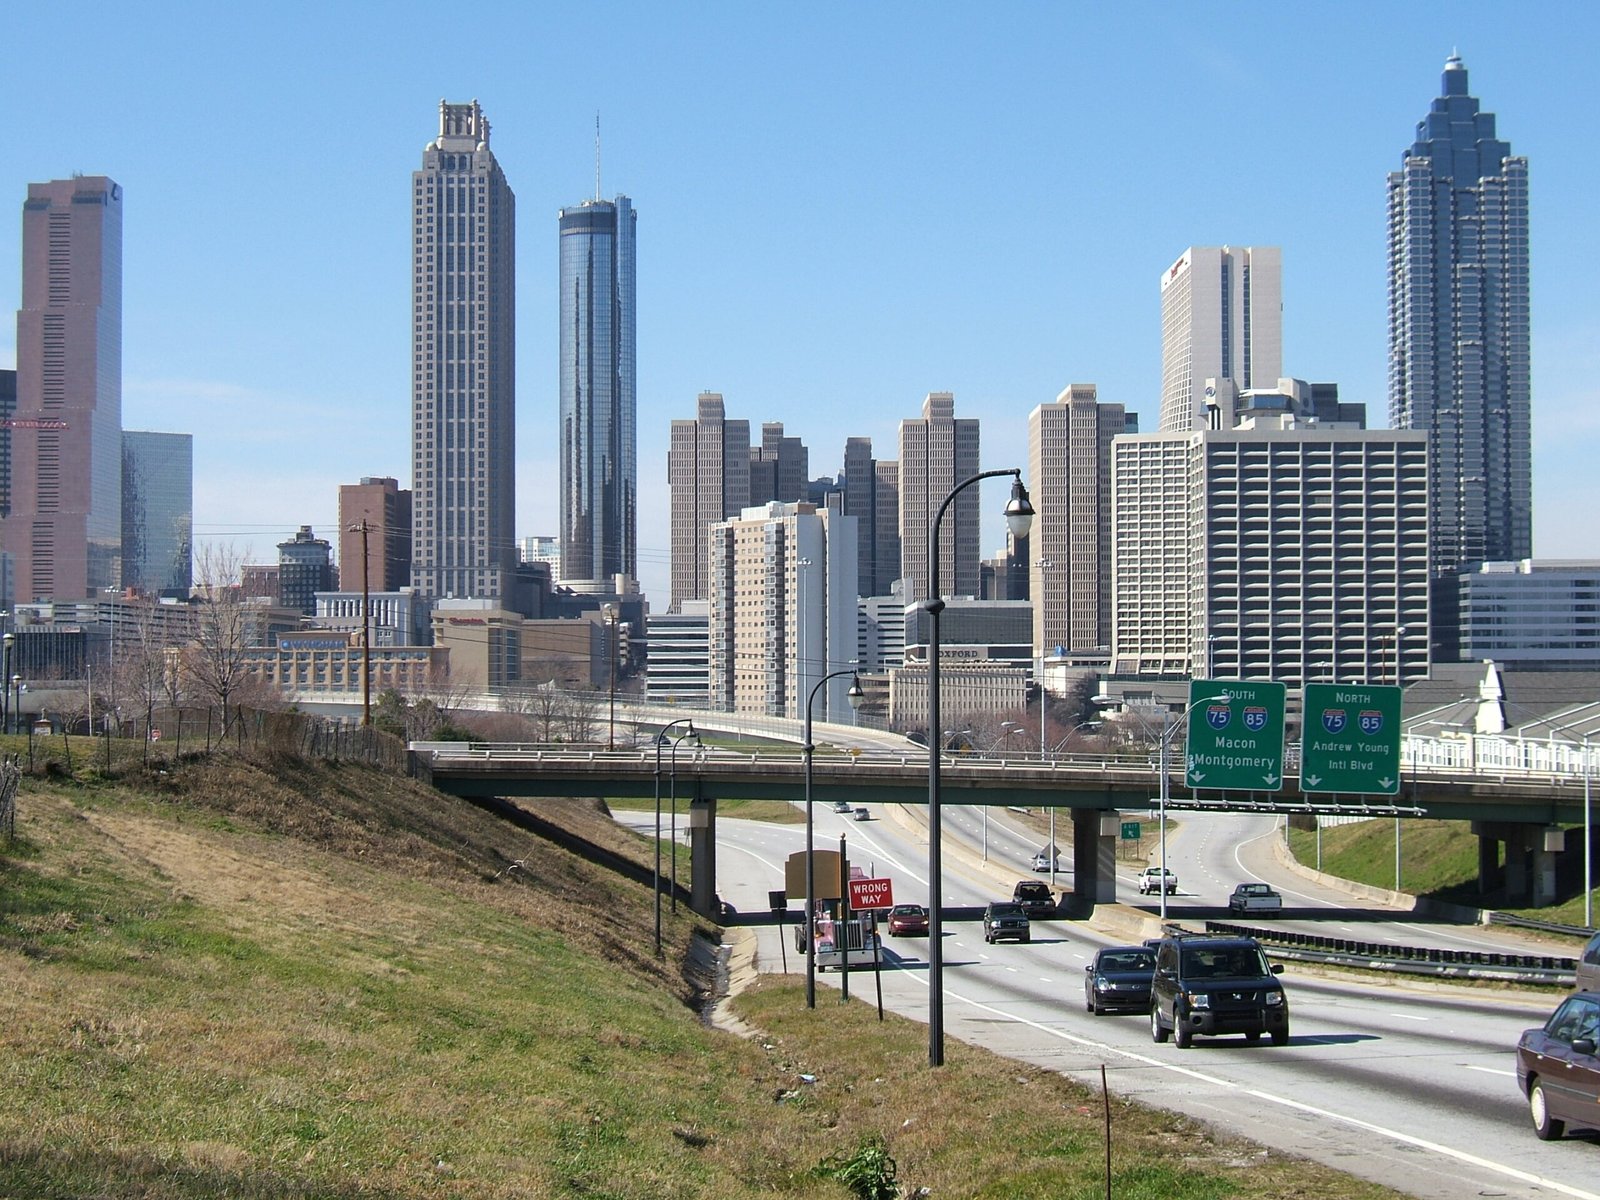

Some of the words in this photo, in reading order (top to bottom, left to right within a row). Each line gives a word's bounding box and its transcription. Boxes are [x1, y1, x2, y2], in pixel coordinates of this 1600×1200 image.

[938, 650, 978, 658] OXFORD
[1221, 688, 1256, 700] SOUTH
[1336, 692, 1371, 704] NORTH
[1210, 711, 1227, 724] 75
[1246, 713, 1264, 726] 85
[1325, 715, 1343, 728] 75
[1361, 717, 1379, 730] 85
[1215, 736, 1256, 749] Macon
[1312, 741, 1352, 752] Andrew
[1357, 742, 1389, 756] Young
[1194, 753, 1275, 771] Montgomery
[1328, 760, 1347, 770] Intl
[1350, 760, 1374, 771] Blvd
[853, 882, 888, 894] WRONG
[861, 894, 882, 905] WAY
